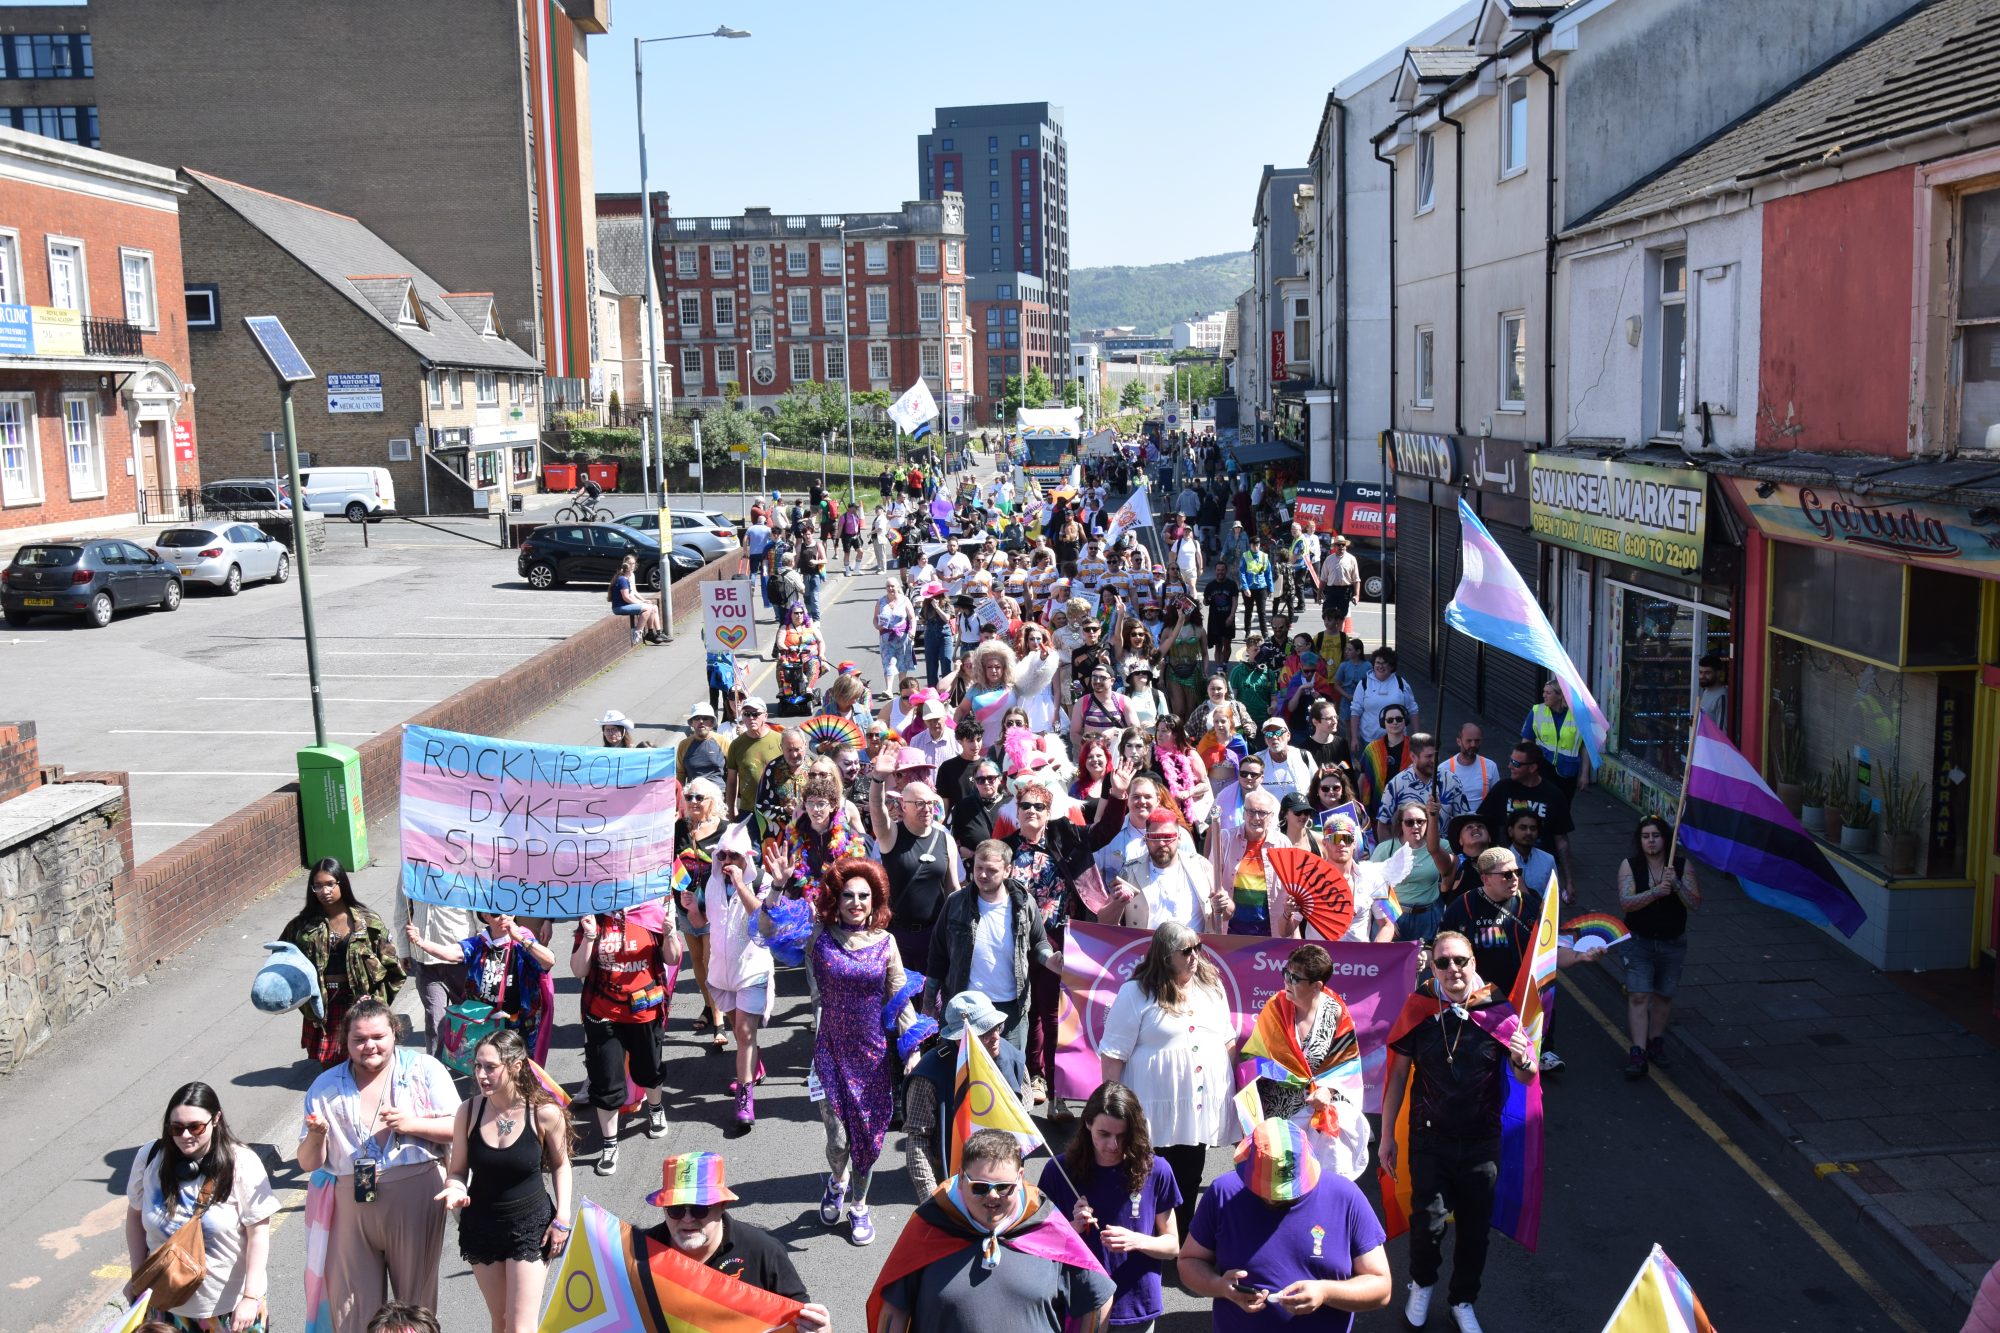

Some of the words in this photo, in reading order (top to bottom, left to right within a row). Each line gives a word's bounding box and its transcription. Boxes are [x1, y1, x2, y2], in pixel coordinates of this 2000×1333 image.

[5, 307, 28, 325] CLINIC
[1299, 502, 1326, 515] ME!
[1531, 466, 1612, 518] SWANSEA
[1614, 477, 1702, 535] MARKET
[1799, 487, 1957, 554] Garuda
[1533, 512, 1554, 536] OPEN
[1554, 519, 1562, 537] 7
[1561, 519, 1580, 542] DAY
[1582, 524, 1590, 546] A
[1592, 526, 1620, 553] WEEK
[1624, 533, 1647, 560] 8:00
[1648, 539, 1664, 564] TO
[1666, 543, 1697, 570] 22:00
[711, 604, 747, 618] YOU
[714, 587, 737, 601] BE
[1937, 700, 1954, 848] RESTAURANT
[469, 789, 607, 835] DYKES
[444, 829, 648, 878] SUPPORT
[407, 856, 519, 913] TRANS
[546, 862, 673, 915] RIGHTS
[599, 939, 638, 954] EOPLE
[599, 953, 616, 963] RE
